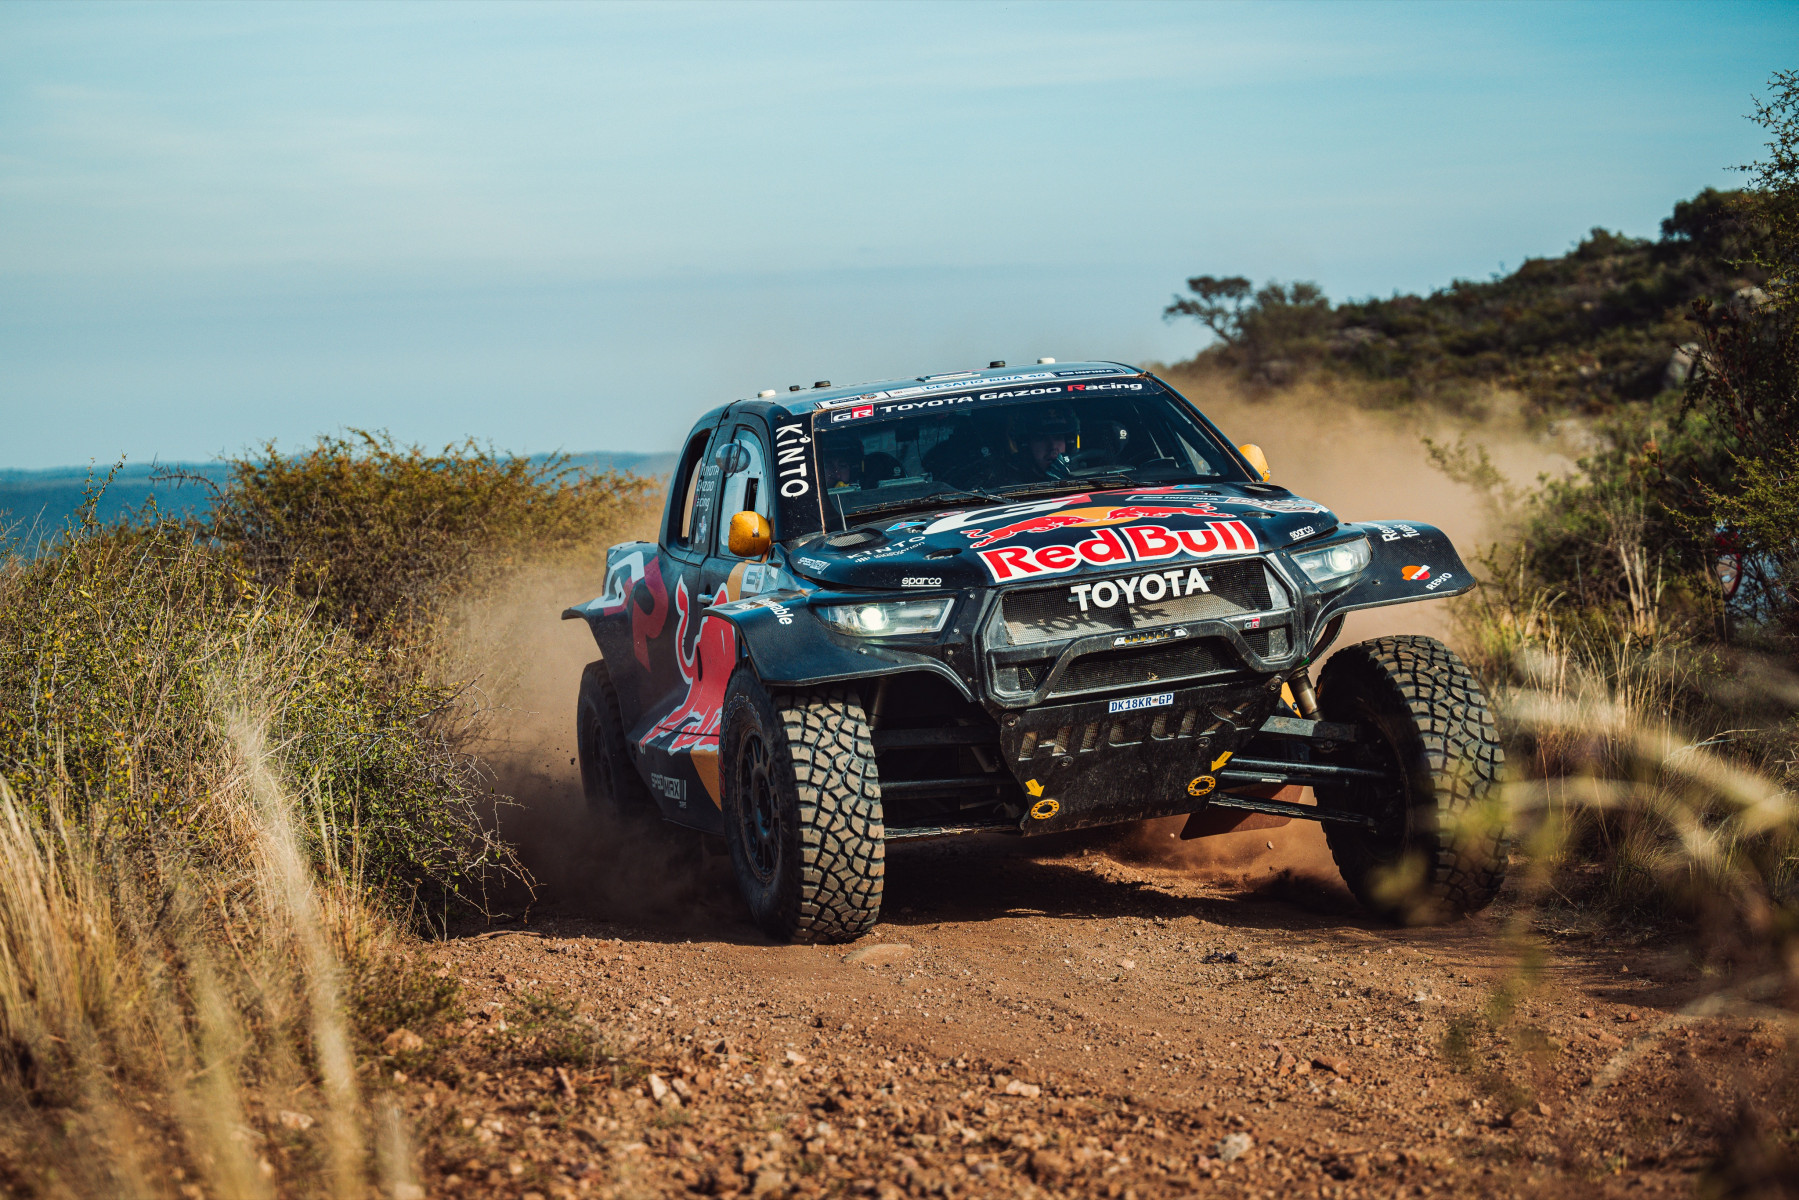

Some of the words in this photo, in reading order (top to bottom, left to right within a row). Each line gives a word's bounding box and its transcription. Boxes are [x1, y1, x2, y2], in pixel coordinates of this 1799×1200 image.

[880, 395, 974, 413] TOYOTA
[979, 387, 1062, 401] GAZOO
[1067, 382, 1143, 392] Racing
[833, 409, 872, 422] GR
[1289, 525, 1316, 540] sparco
[978, 528, 1132, 583] Red
[1125, 520, 1259, 562] Bull
[901, 577, 942, 588] sparco
[1070, 567, 1211, 612] TOYOTA
[1244, 618, 1260, 629] GR
[1111, 696, 1152, 712] DK18KR
[1158, 693, 1173, 705] GP
